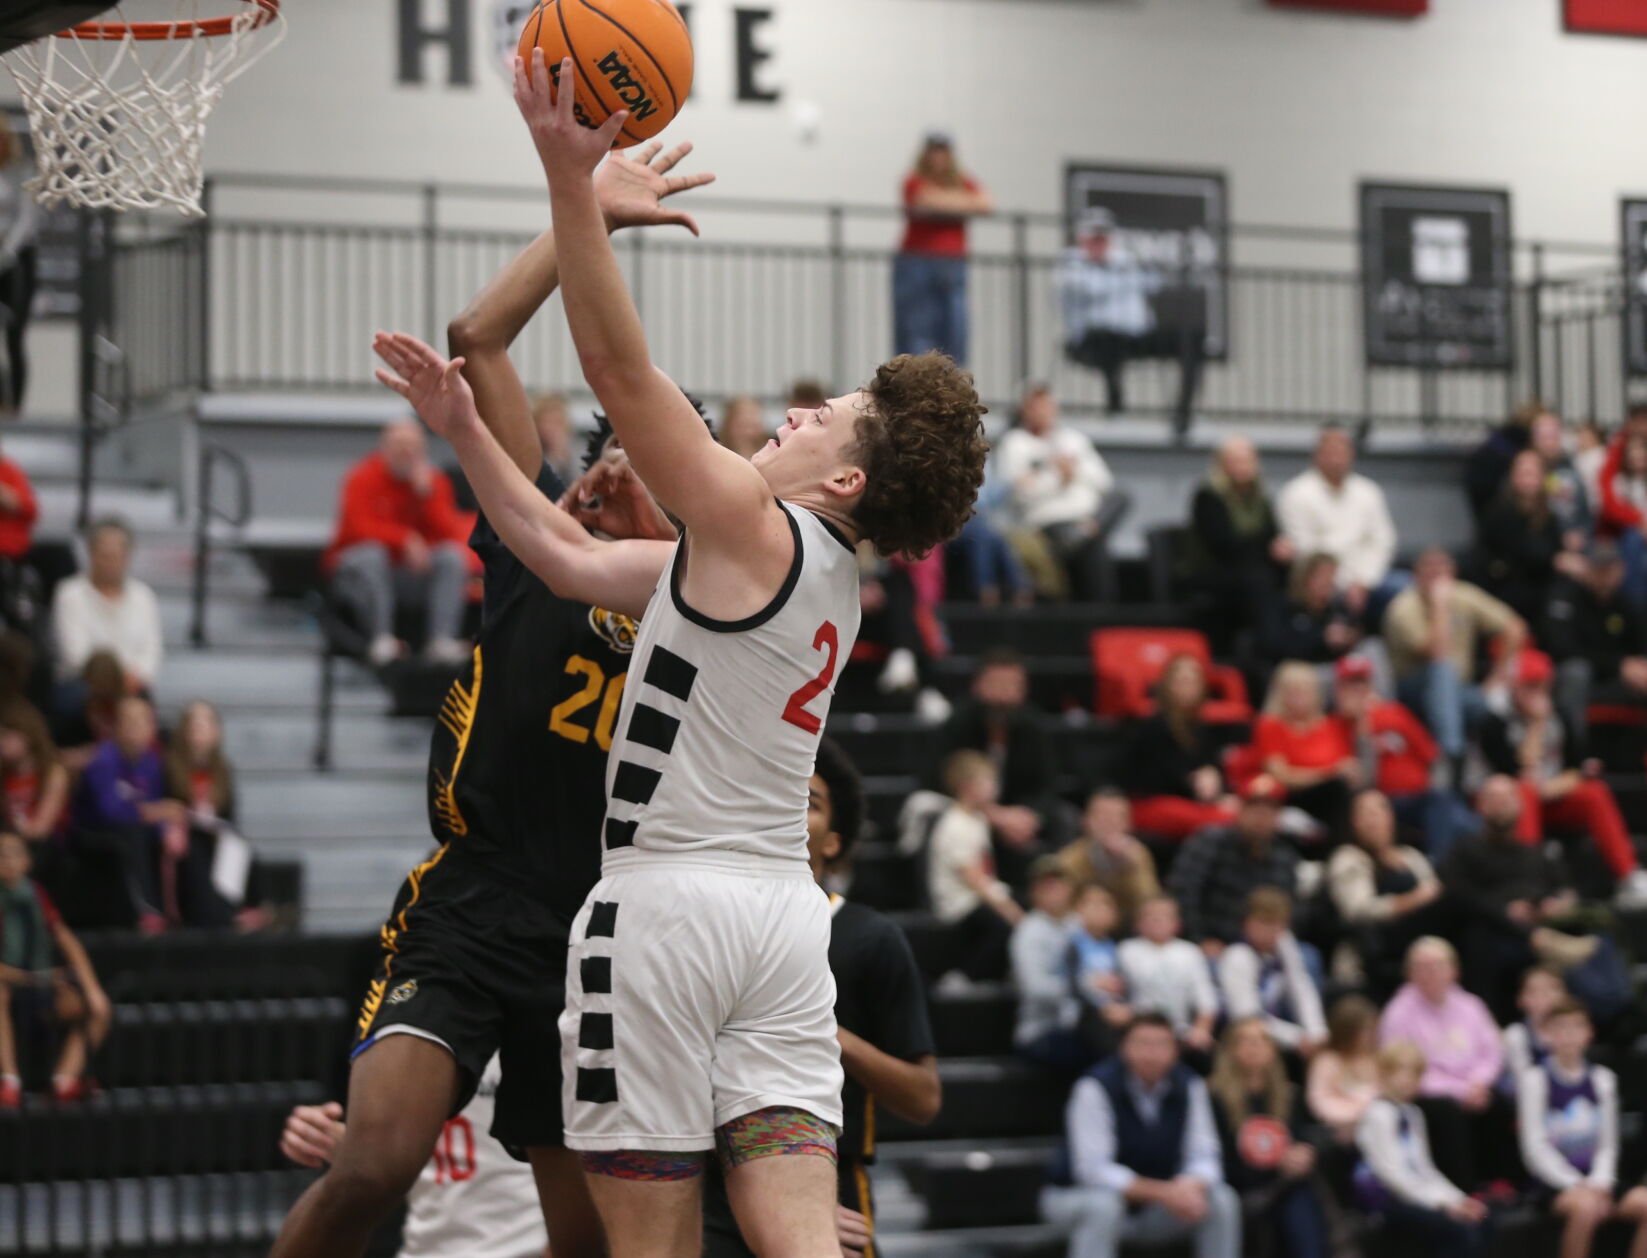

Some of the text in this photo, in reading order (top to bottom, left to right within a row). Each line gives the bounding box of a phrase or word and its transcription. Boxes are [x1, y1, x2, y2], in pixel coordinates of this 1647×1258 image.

[597, 50, 658, 121] NCAA
[549, 654, 628, 751] 20
[782, 620, 839, 735] 2
